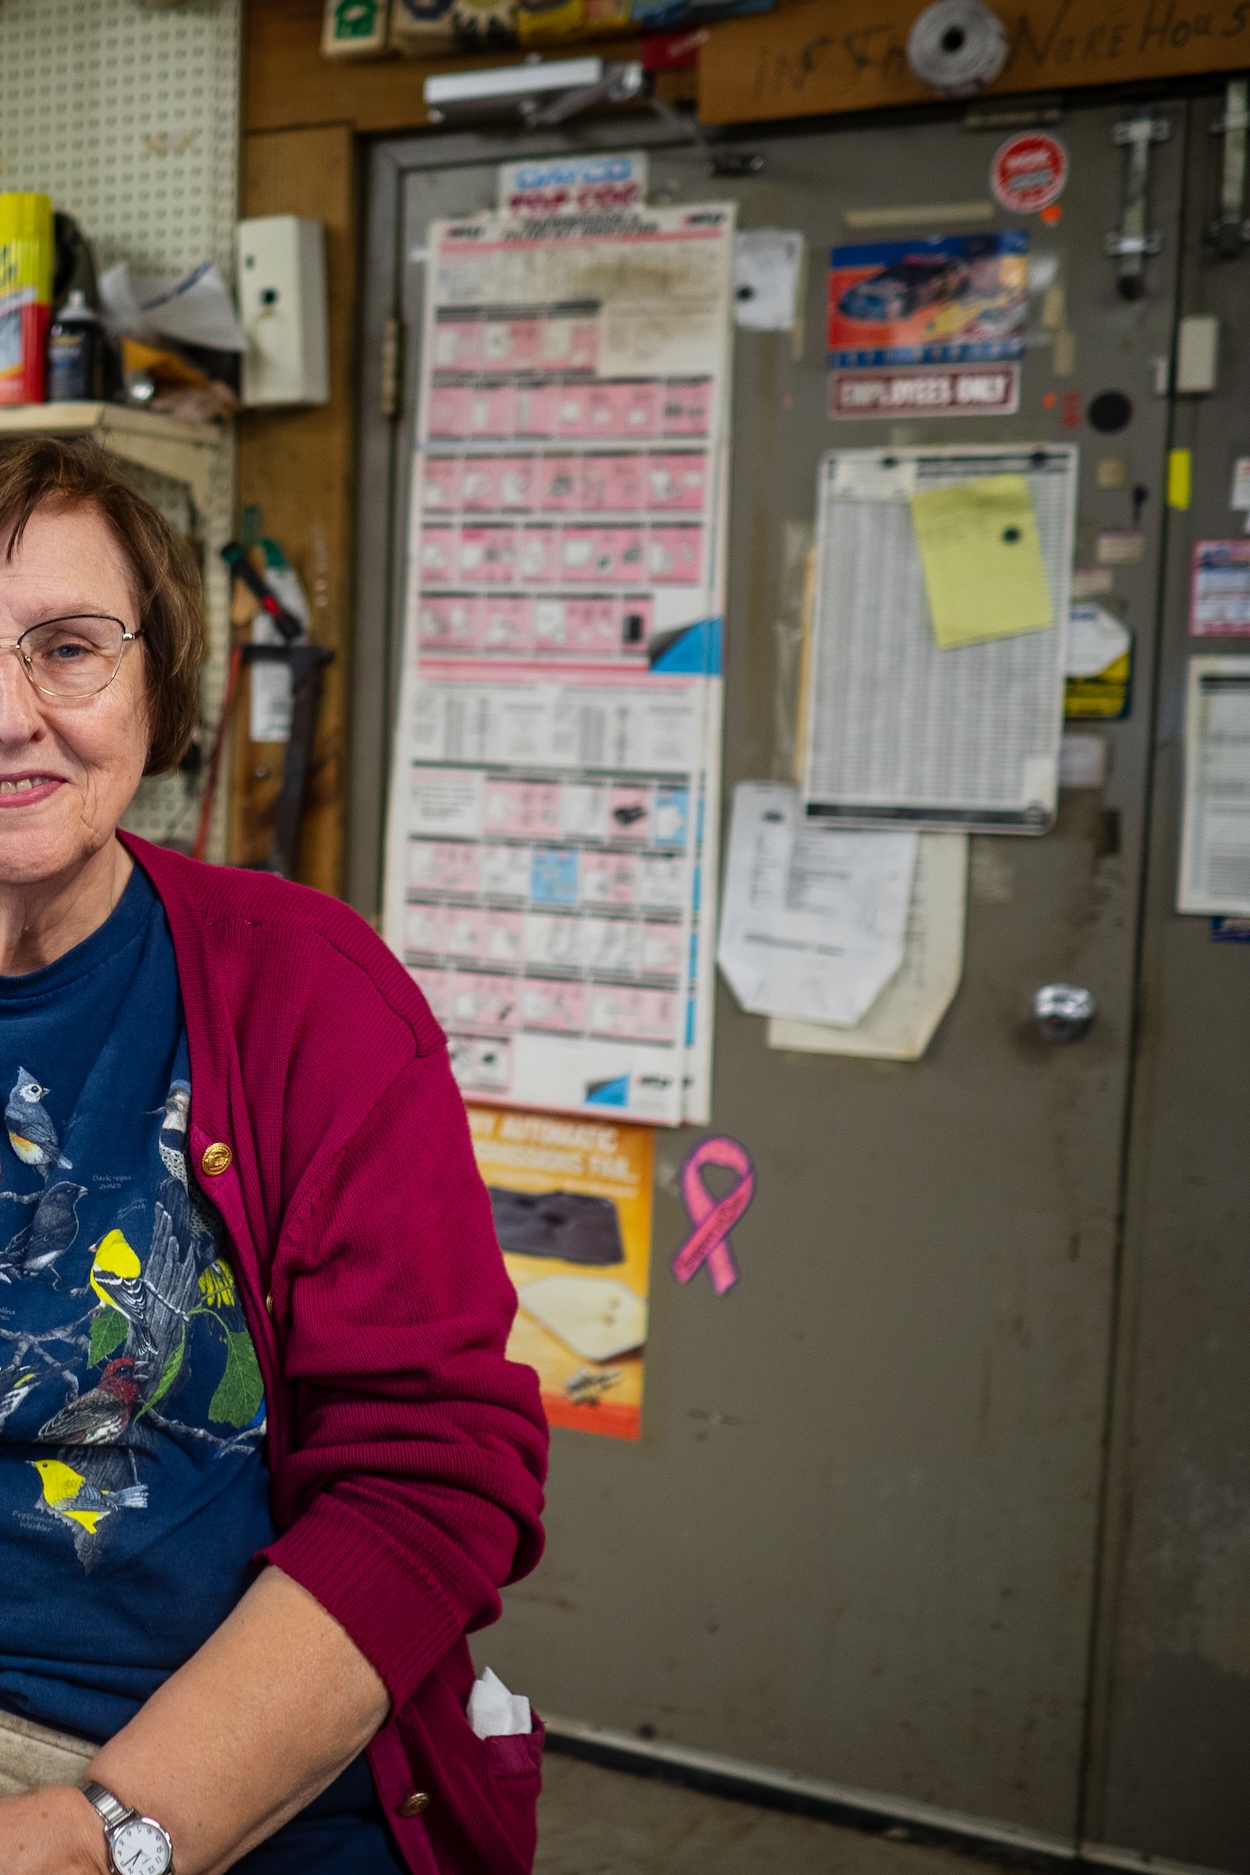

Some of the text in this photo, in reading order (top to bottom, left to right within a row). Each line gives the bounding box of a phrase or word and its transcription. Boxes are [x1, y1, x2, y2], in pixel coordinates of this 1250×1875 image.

[841, 372, 1009, 408] EMPLOYEES ONLY
[502, 1114, 618, 1153] AUTOMATIC
[92, 1174, 132, 1183] Dark-eyed
[19, 1520, 53, 1532] Warbler
[156, 1845, 165, 1854] 10
[155, 1856, 163, 1865] 11
[147, 1865, 156, 1875] 12
